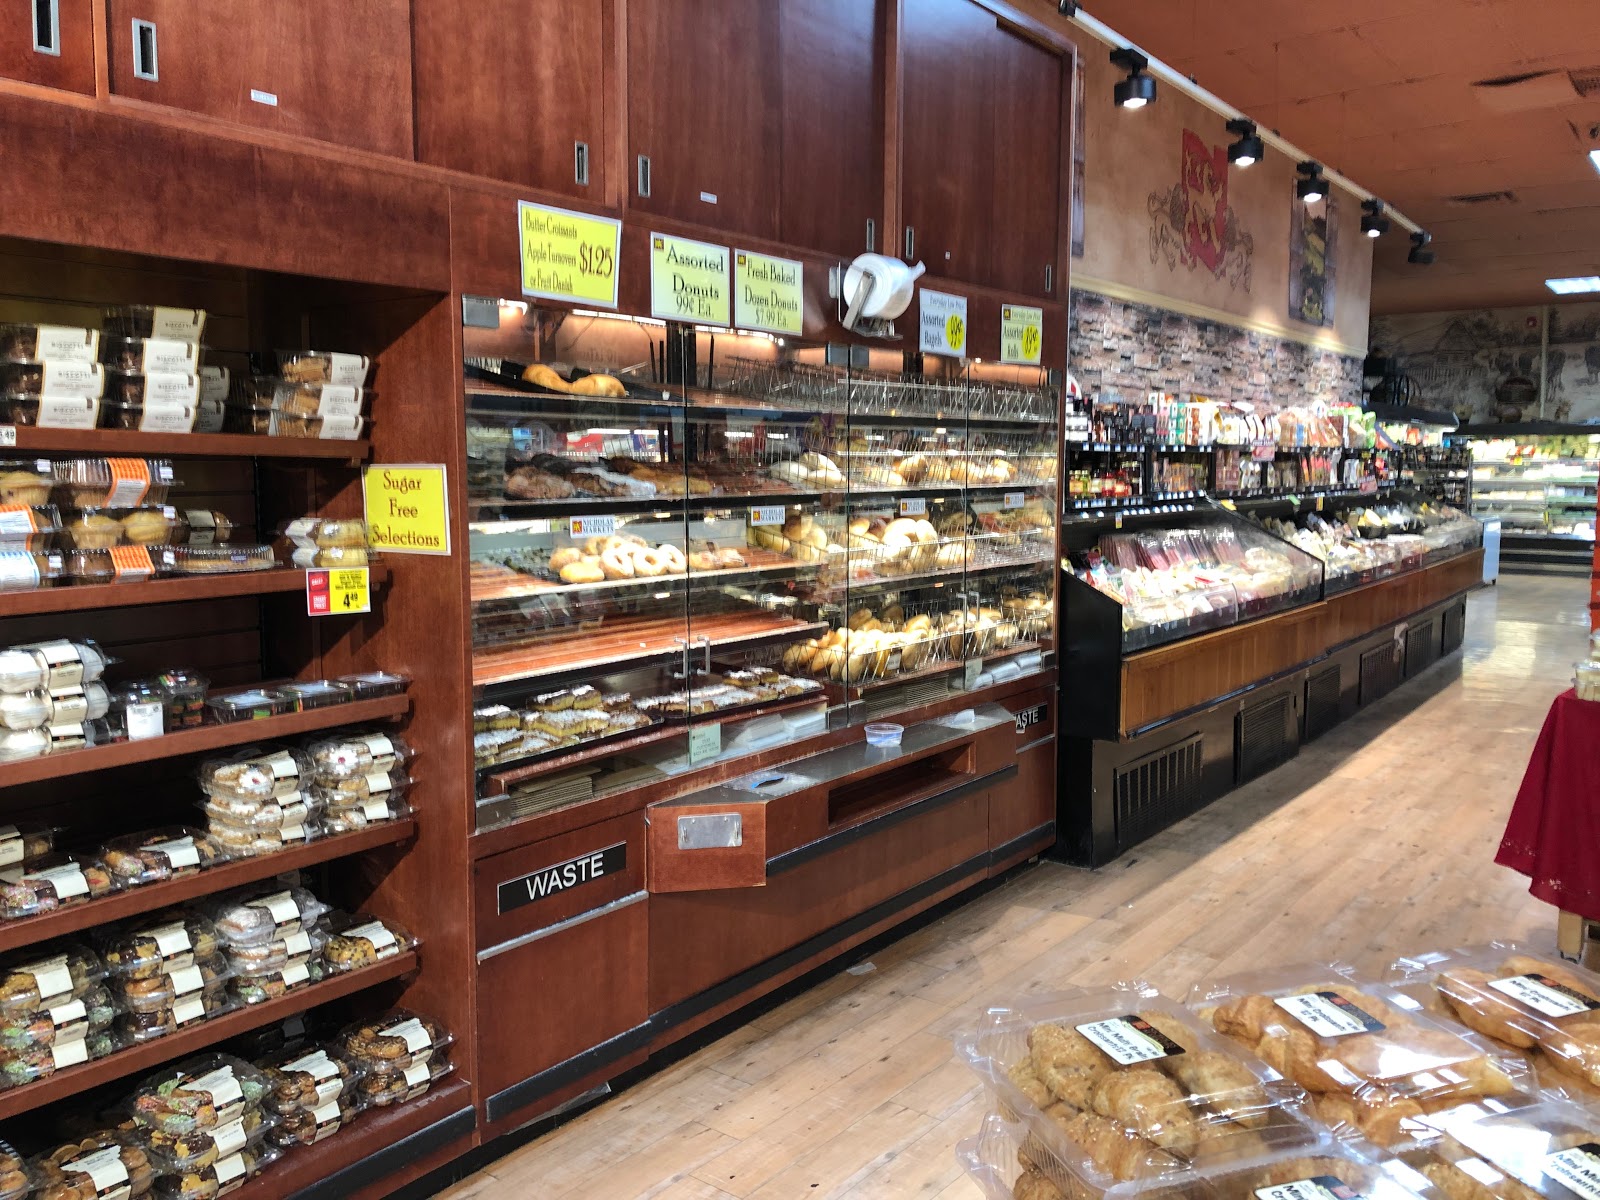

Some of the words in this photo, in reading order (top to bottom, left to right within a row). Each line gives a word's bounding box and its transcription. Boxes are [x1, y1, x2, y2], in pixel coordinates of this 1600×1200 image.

[525, 209, 546, 233] Butter
[546, 214, 577, 240] Croissants
[526, 238, 547, 265] Apple
[547, 242, 576, 267] Turnovers
[579, 240, 613, 279] $1.25
[665, 243, 724, 274] Assorted
[529, 274, 536, 287] or
[537, 267, 552, 289] Fruit
[552, 269, 573, 292] Danish
[746, 258, 769, 280] Fresh
[770, 263, 796, 287] Baked
[672, 272, 720, 300] Donuts
[744, 284, 769, 309] Dozen
[770, 289, 798, 313] Donuts
[676, 293, 695, 316] 99¢
[755, 307, 775, 327] $7.99
[922, 310, 946, 329] Assorted
[924, 329, 943, 349] Bagels
[1003, 324, 1024, 341] Assorted
[383, 469, 422, 494] Sugar
[389, 497, 419, 518] Free
[372, 523, 440, 547] Selections
[1015, 709, 1039, 728] ASTE
[526, 852, 604, 900] WASTE
[1097, 1022, 1115, 1033] Mini
[1111, 1032, 1133, 1046] Multi
